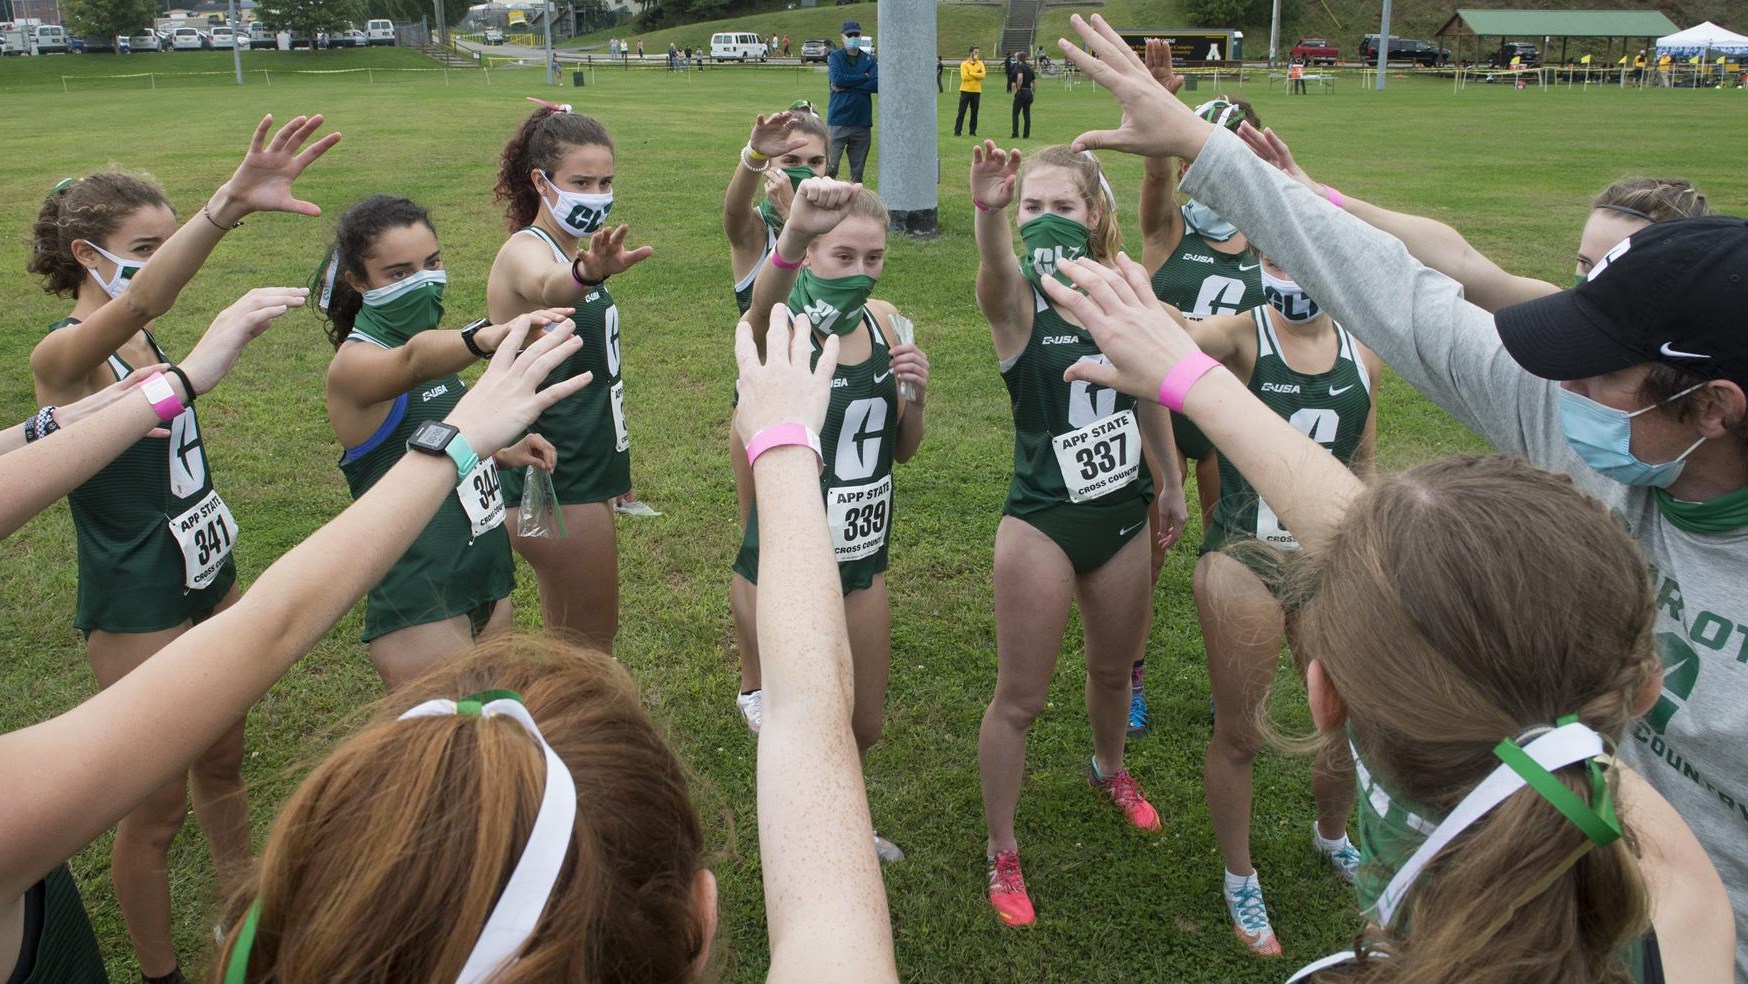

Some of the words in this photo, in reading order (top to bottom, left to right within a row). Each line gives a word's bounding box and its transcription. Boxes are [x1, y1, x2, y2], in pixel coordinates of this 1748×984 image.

[1062, 432, 1088, 450] APP
[1091, 415, 1129, 438] STATE
[1075, 432, 1127, 480] 337
[473, 464, 500, 510] 344
[837, 492, 864, 504] APP
[866, 481, 890, 499] STATE
[1078, 480, 1107, 495] CROSS
[181, 513, 200, 533] APP
[200, 495, 221, 519] STATE
[480, 511, 495, 526] CROSS
[843, 500, 886, 541] 339
[195, 513, 231, 566] 341
[834, 544, 861, 554] CROSS
[194, 564, 216, 583] CROSS
